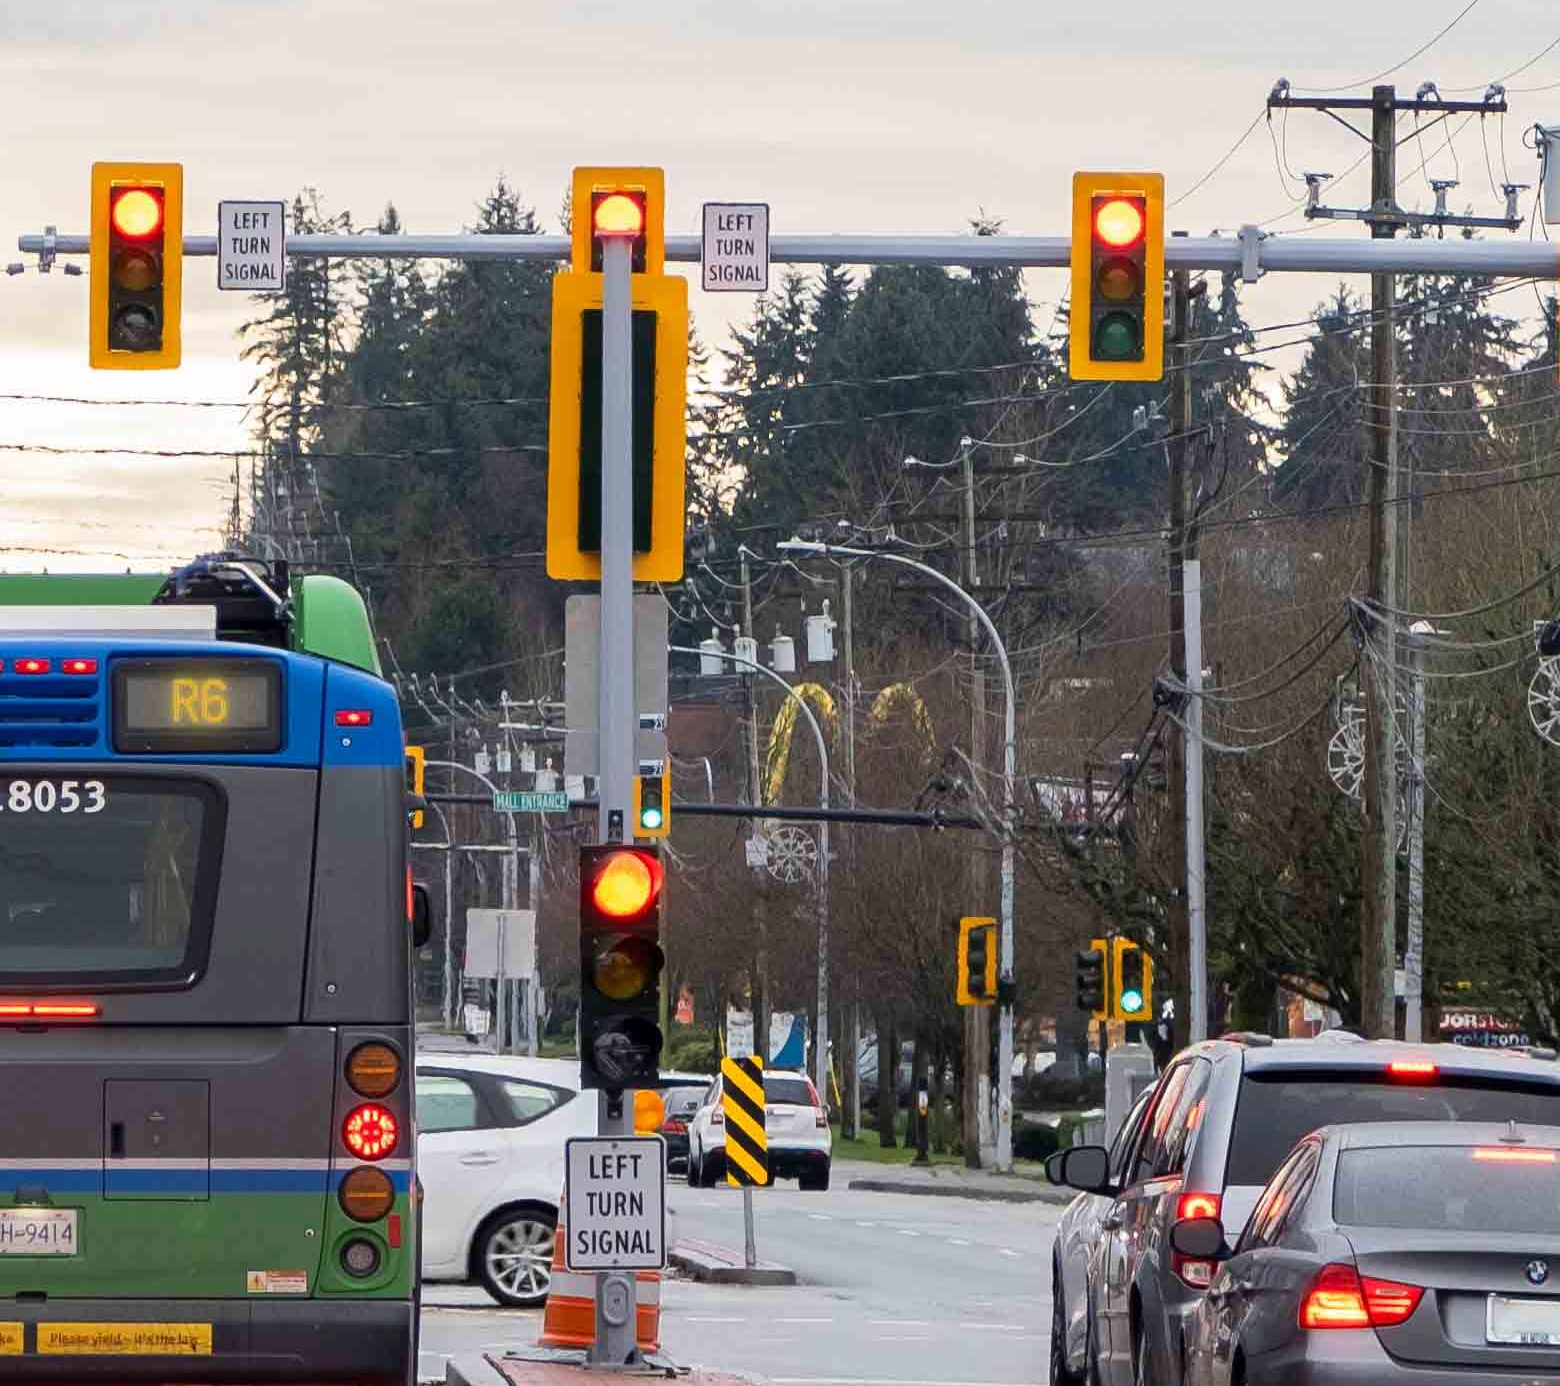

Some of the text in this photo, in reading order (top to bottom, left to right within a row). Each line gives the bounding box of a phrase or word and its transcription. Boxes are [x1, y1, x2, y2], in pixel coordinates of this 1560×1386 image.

[233, 212, 270, 229] LEFT
[718, 214, 753, 231] LEFT
[232, 237, 270, 254] TURN
[716, 239, 754, 256] TURN
[225, 263, 278, 280] SIGNAL
[709, 264, 761, 282] SIGNAL
[171, 678, 228, 724] R6
[495, 793, 567, 811] MALL ENTRANCE
[589, 1154, 642, 1180] LEFT
[586, 1191, 644, 1217] TURN
[577, 1229, 655, 1255] SIGNAL
[50, 1332, 90, 1345] Please
[92, 1332, 120, 1348] yield
